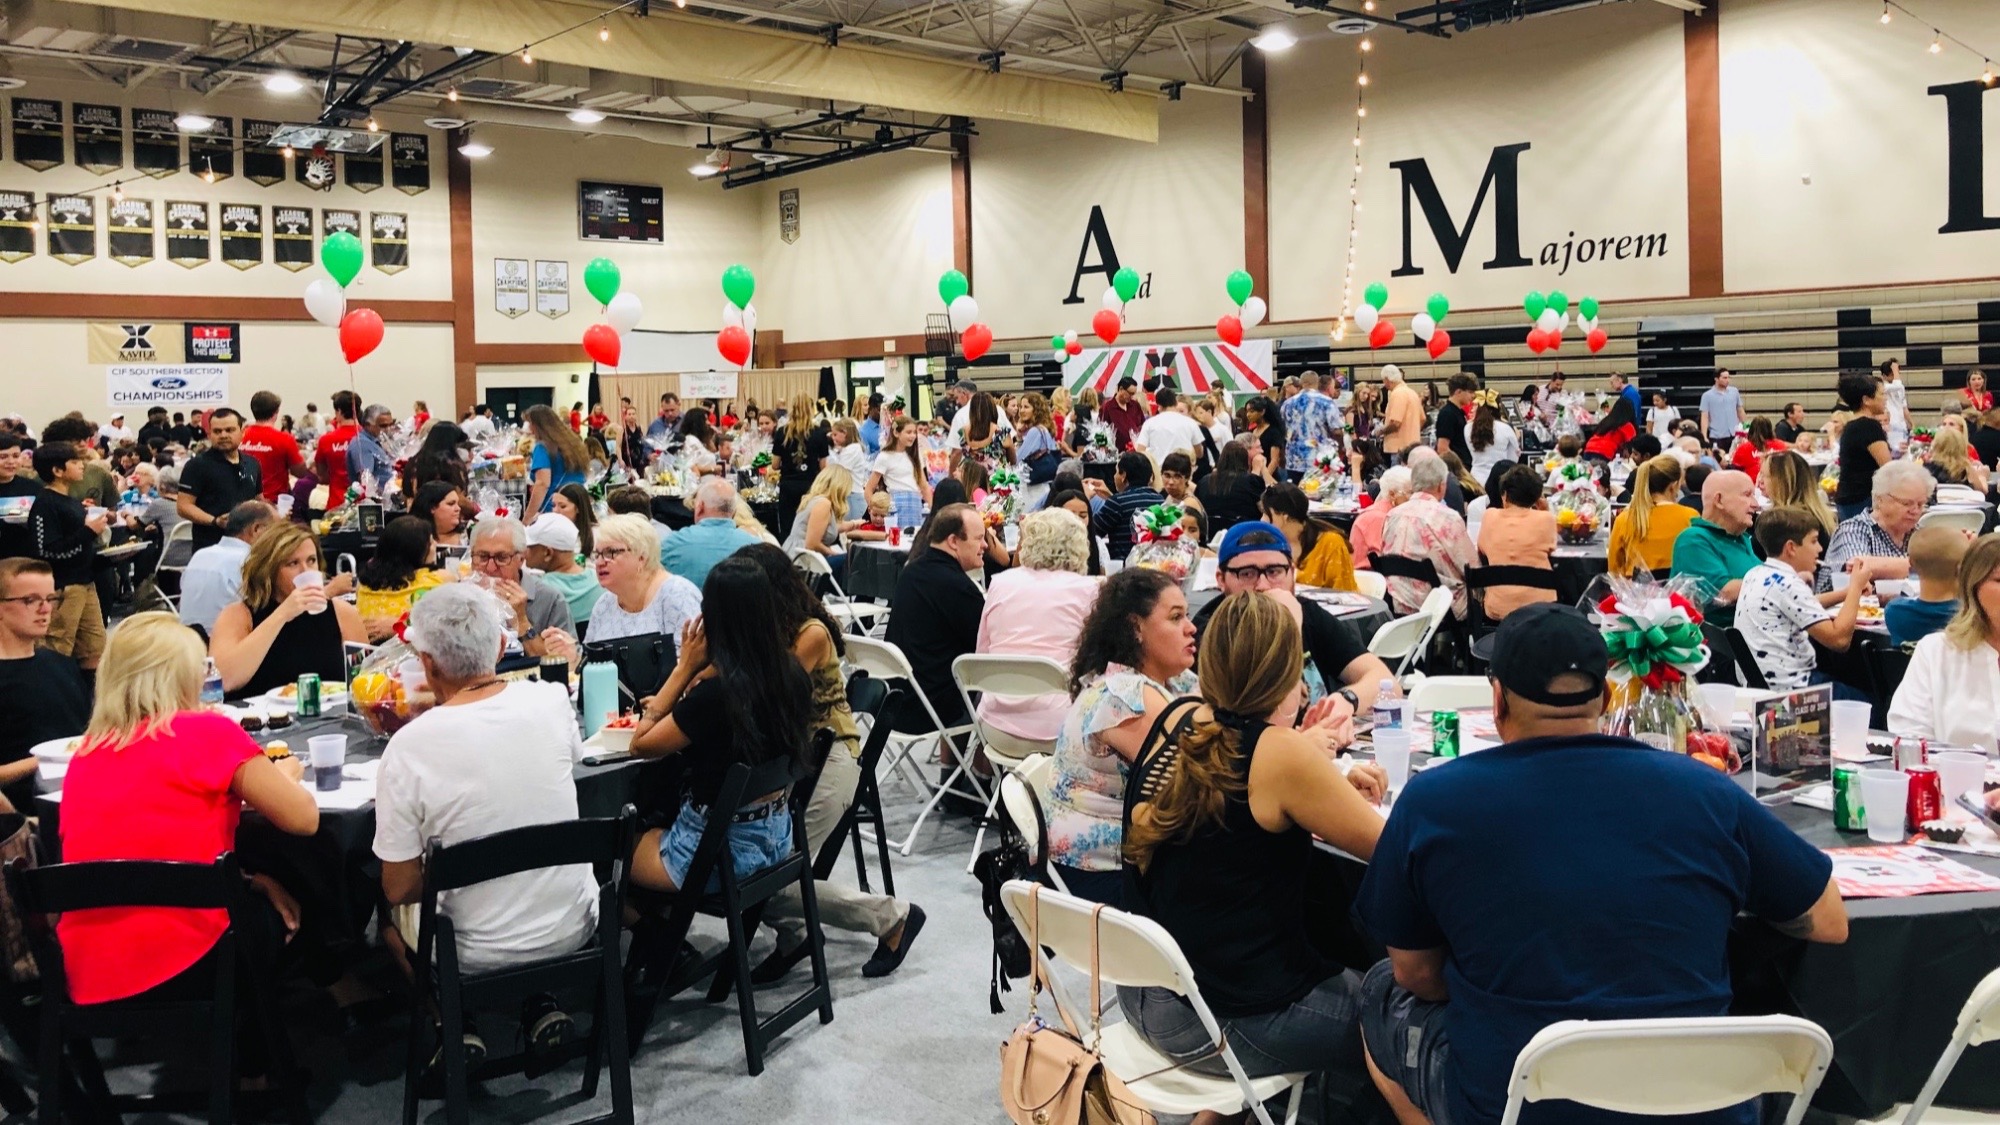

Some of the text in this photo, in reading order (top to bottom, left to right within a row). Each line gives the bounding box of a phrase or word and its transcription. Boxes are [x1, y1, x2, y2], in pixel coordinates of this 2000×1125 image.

[1389, 141, 1668, 276] Majorem
[192, 339, 231, 348] PROTECT
[119, 350, 156, 359] XAVIER
[193, 348, 208, 356] THIS
[112, 367, 223, 376] CIF SOUTHERN SECTION
[156, 379, 182, 389] Ford
[113, 390, 223, 401] CHAMPIONSHIPS
